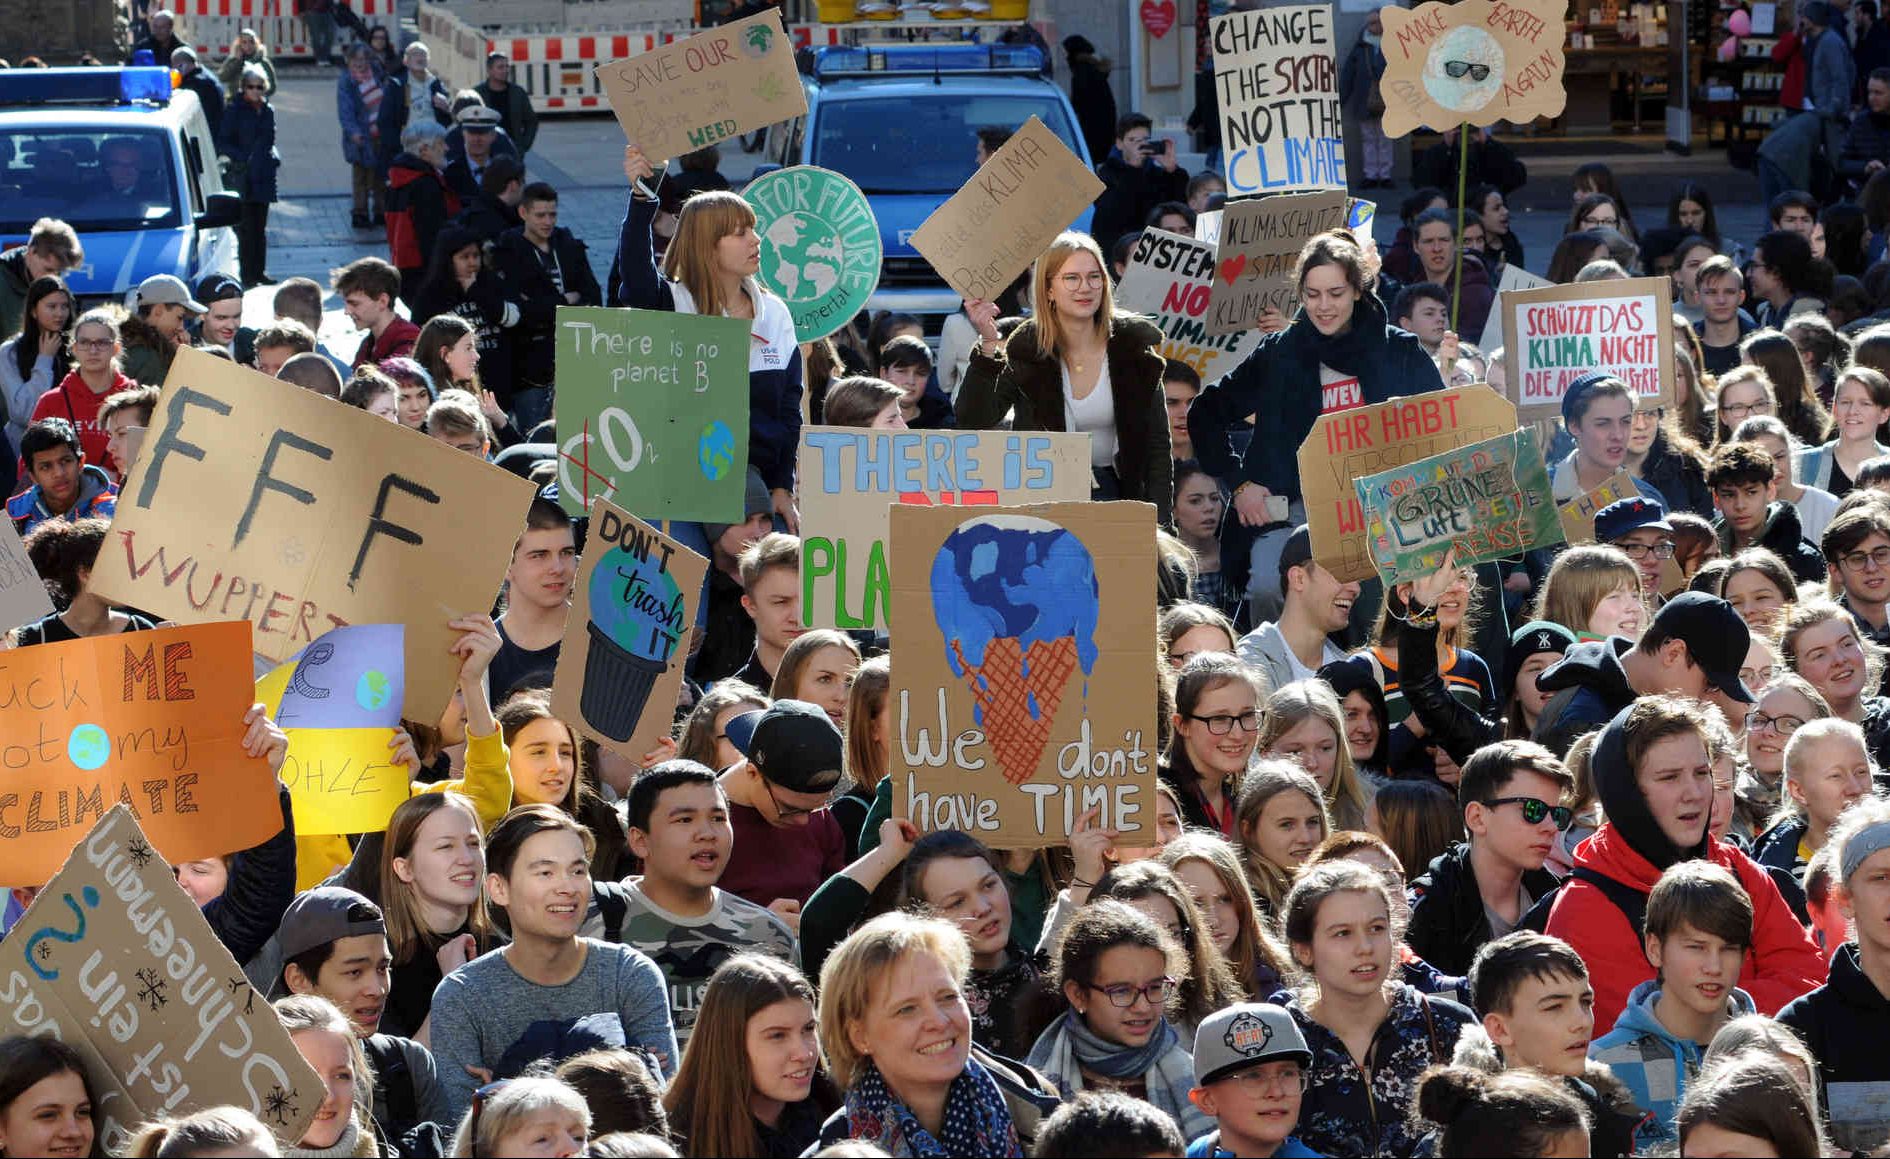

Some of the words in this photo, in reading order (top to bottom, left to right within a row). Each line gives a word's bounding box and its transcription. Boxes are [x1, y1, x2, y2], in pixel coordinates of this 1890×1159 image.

[1214, 9, 1327, 54] CHANGE
[1395, 7, 1448, 60] MAKE
[1486, 1, 1546, 44] EARTH
[619, 54, 683, 94] SAVE
[684, 38, 738, 73] OUR
[1216, 63, 1270, 107] THE
[1502, 48, 1558, 107] AGAIN
[686, 119, 737, 148] WEED
[1227, 99, 1296, 150] NOT
[1300, 98, 1342, 144] THE
[978, 136, 1048, 206] KLIMA
[1228, 135, 1346, 192] CLIMATE
[754, 172, 812, 218] FOR
[816, 177, 876, 292] FUTURE
[1226, 205, 1341, 246] KLIMASCHUTZ
[1132, 232, 1216, 281] SYSTEM
[790, 288, 850, 332] uppertal
[1161, 280, 1213, 317] NO
[1214, 288, 1300, 327] KLIMASCH
[1526, 304, 1597, 337] SCHÜTZT
[1599, 301, 1644, 334] DAS
[562, 321, 653, 355] There
[670, 329, 684, 359] is
[696, 344, 719, 360] no
[1528, 335, 1599, 369] KLIMA,
[1600, 334, 1657, 366] NICHT
[611, 361, 680, 393] planet
[694, 360, 710, 393] B
[1524, 370, 1551, 397] DIE
[1325, 413, 1374, 455] IHR
[1381, 394, 1461, 444] HABT
[805, 432, 983, 493] THERE
[599, 510, 676, 574] DON'T
[1335, 497, 1366, 537] WI
[118, 529, 350, 643] WUPPER
[617, 565, 689, 634] trash
[802, 536, 890, 628] PLA
[0, 656, 88, 710] uck
[122, 641, 195, 703] ME
[117, 723, 191, 770] my
[900, 687, 986, 770] We
[1057, 718, 1149, 780] don't
[280, 755, 392, 796] OHLE
[0, 773, 199, 839] CLIMATE
[906, 771, 1000, 832] have
[1018, 783, 1143, 837] TIME
[86, 819, 291, 1116] Schneemann
[79, 949, 140, 1043] ein
[125, 1042, 190, 1121] ist
